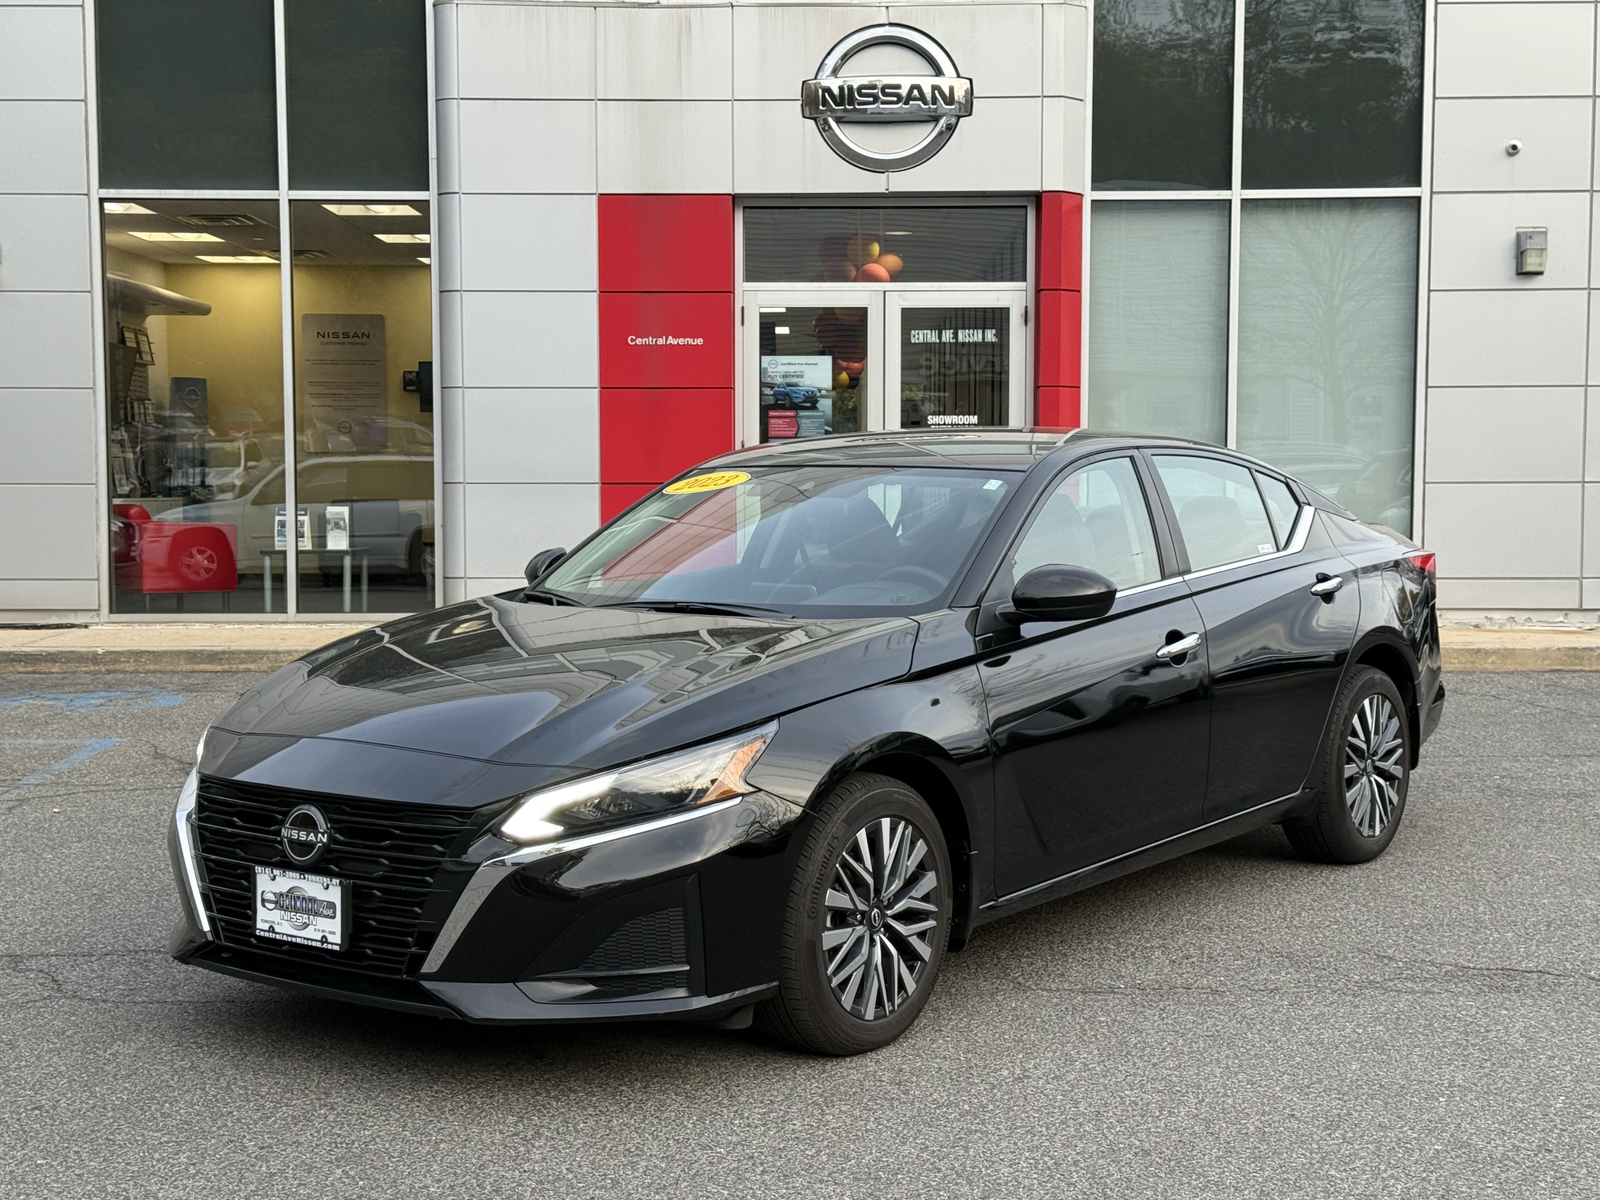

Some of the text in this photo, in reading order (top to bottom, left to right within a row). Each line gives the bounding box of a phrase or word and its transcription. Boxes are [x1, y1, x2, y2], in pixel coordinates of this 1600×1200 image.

[819, 84, 956, 109] NISSAN
[316, 331, 370, 339] NISSAN
[627, 335, 704, 345] Central Avenue
[910, 328, 998, 343] CENTRAL AVE. NISSAN INC.
[927, 415, 978, 425] SHOWROOM
[672, 474, 740, 491] 2023
[281, 827, 328, 843] NISSAN
[807, 842, 836, 920] Continental
[280, 910, 318, 926] NISSAN
